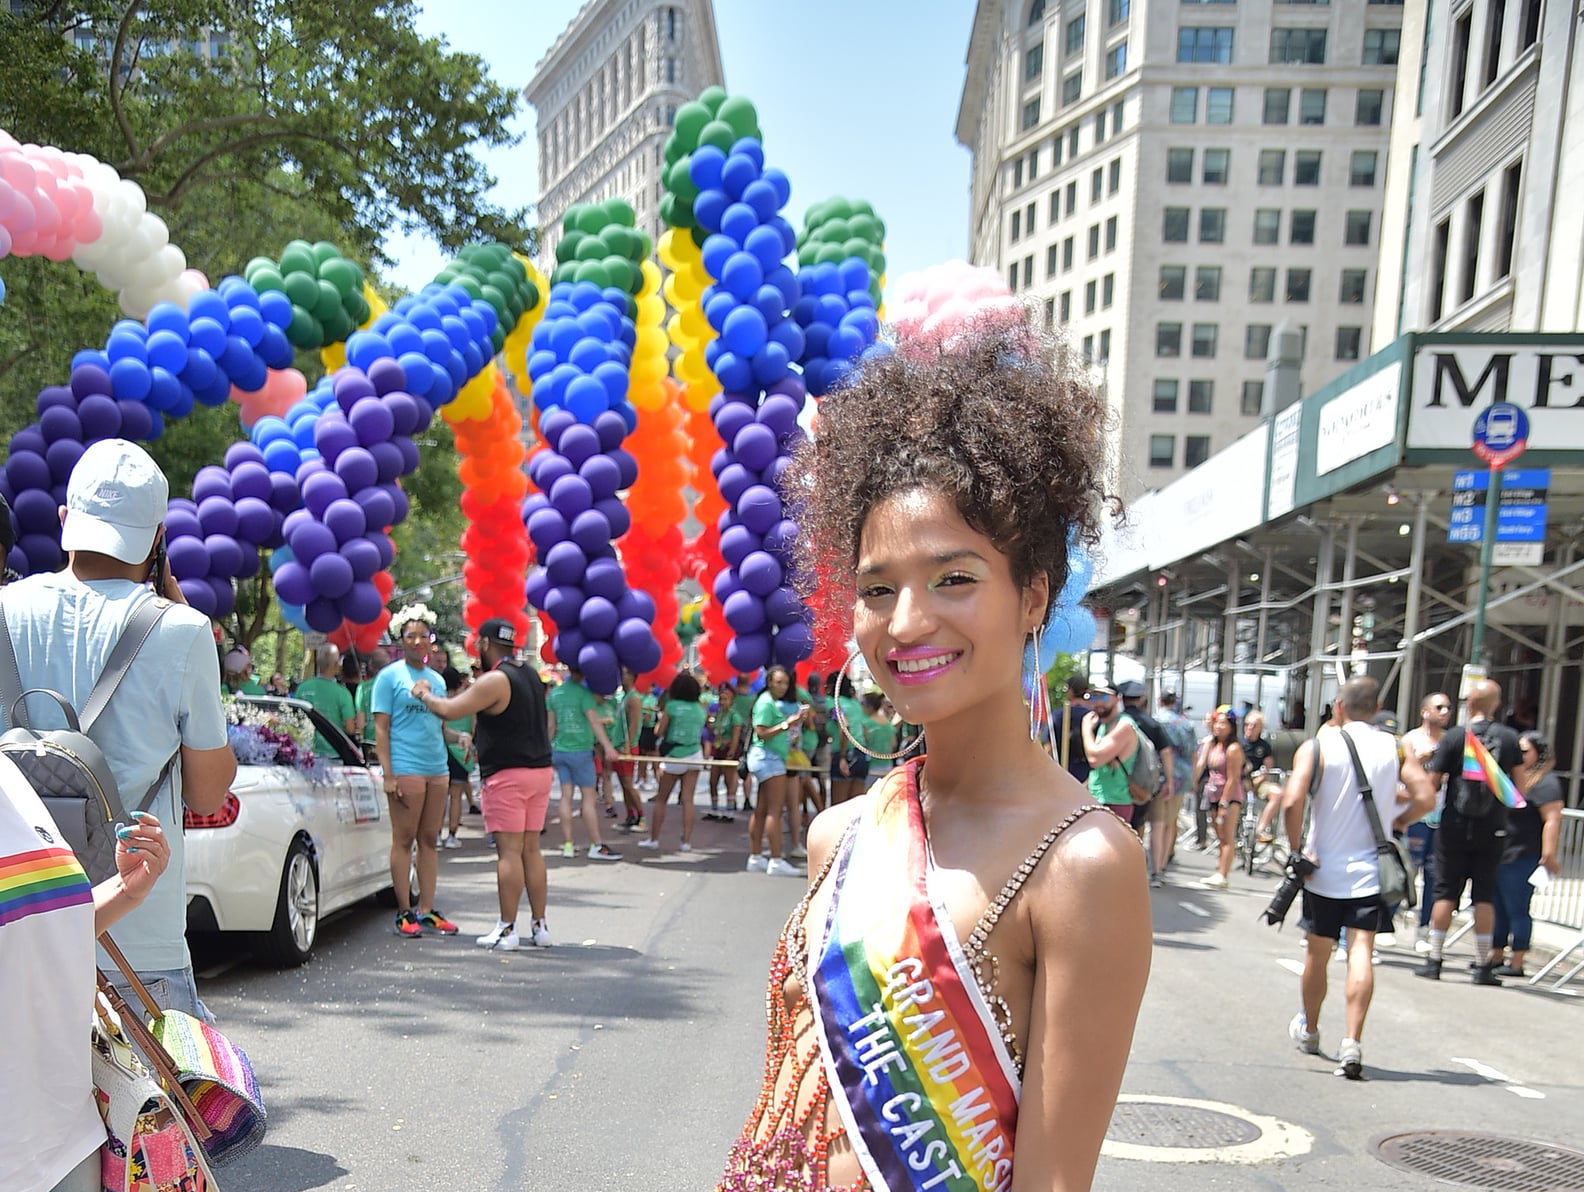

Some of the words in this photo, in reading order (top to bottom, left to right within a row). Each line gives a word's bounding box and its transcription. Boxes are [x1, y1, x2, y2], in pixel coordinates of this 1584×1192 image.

[1454, 472, 1475, 489] M1
[98, 488, 120, 499] NIKE
[1453, 490, 1476, 506] M2
[1451, 507, 1474, 523] M3
[886, 957, 970, 1084] GRAND
[848, 1002, 908, 1087] THE
[881, 1092, 962, 1190] CAST
